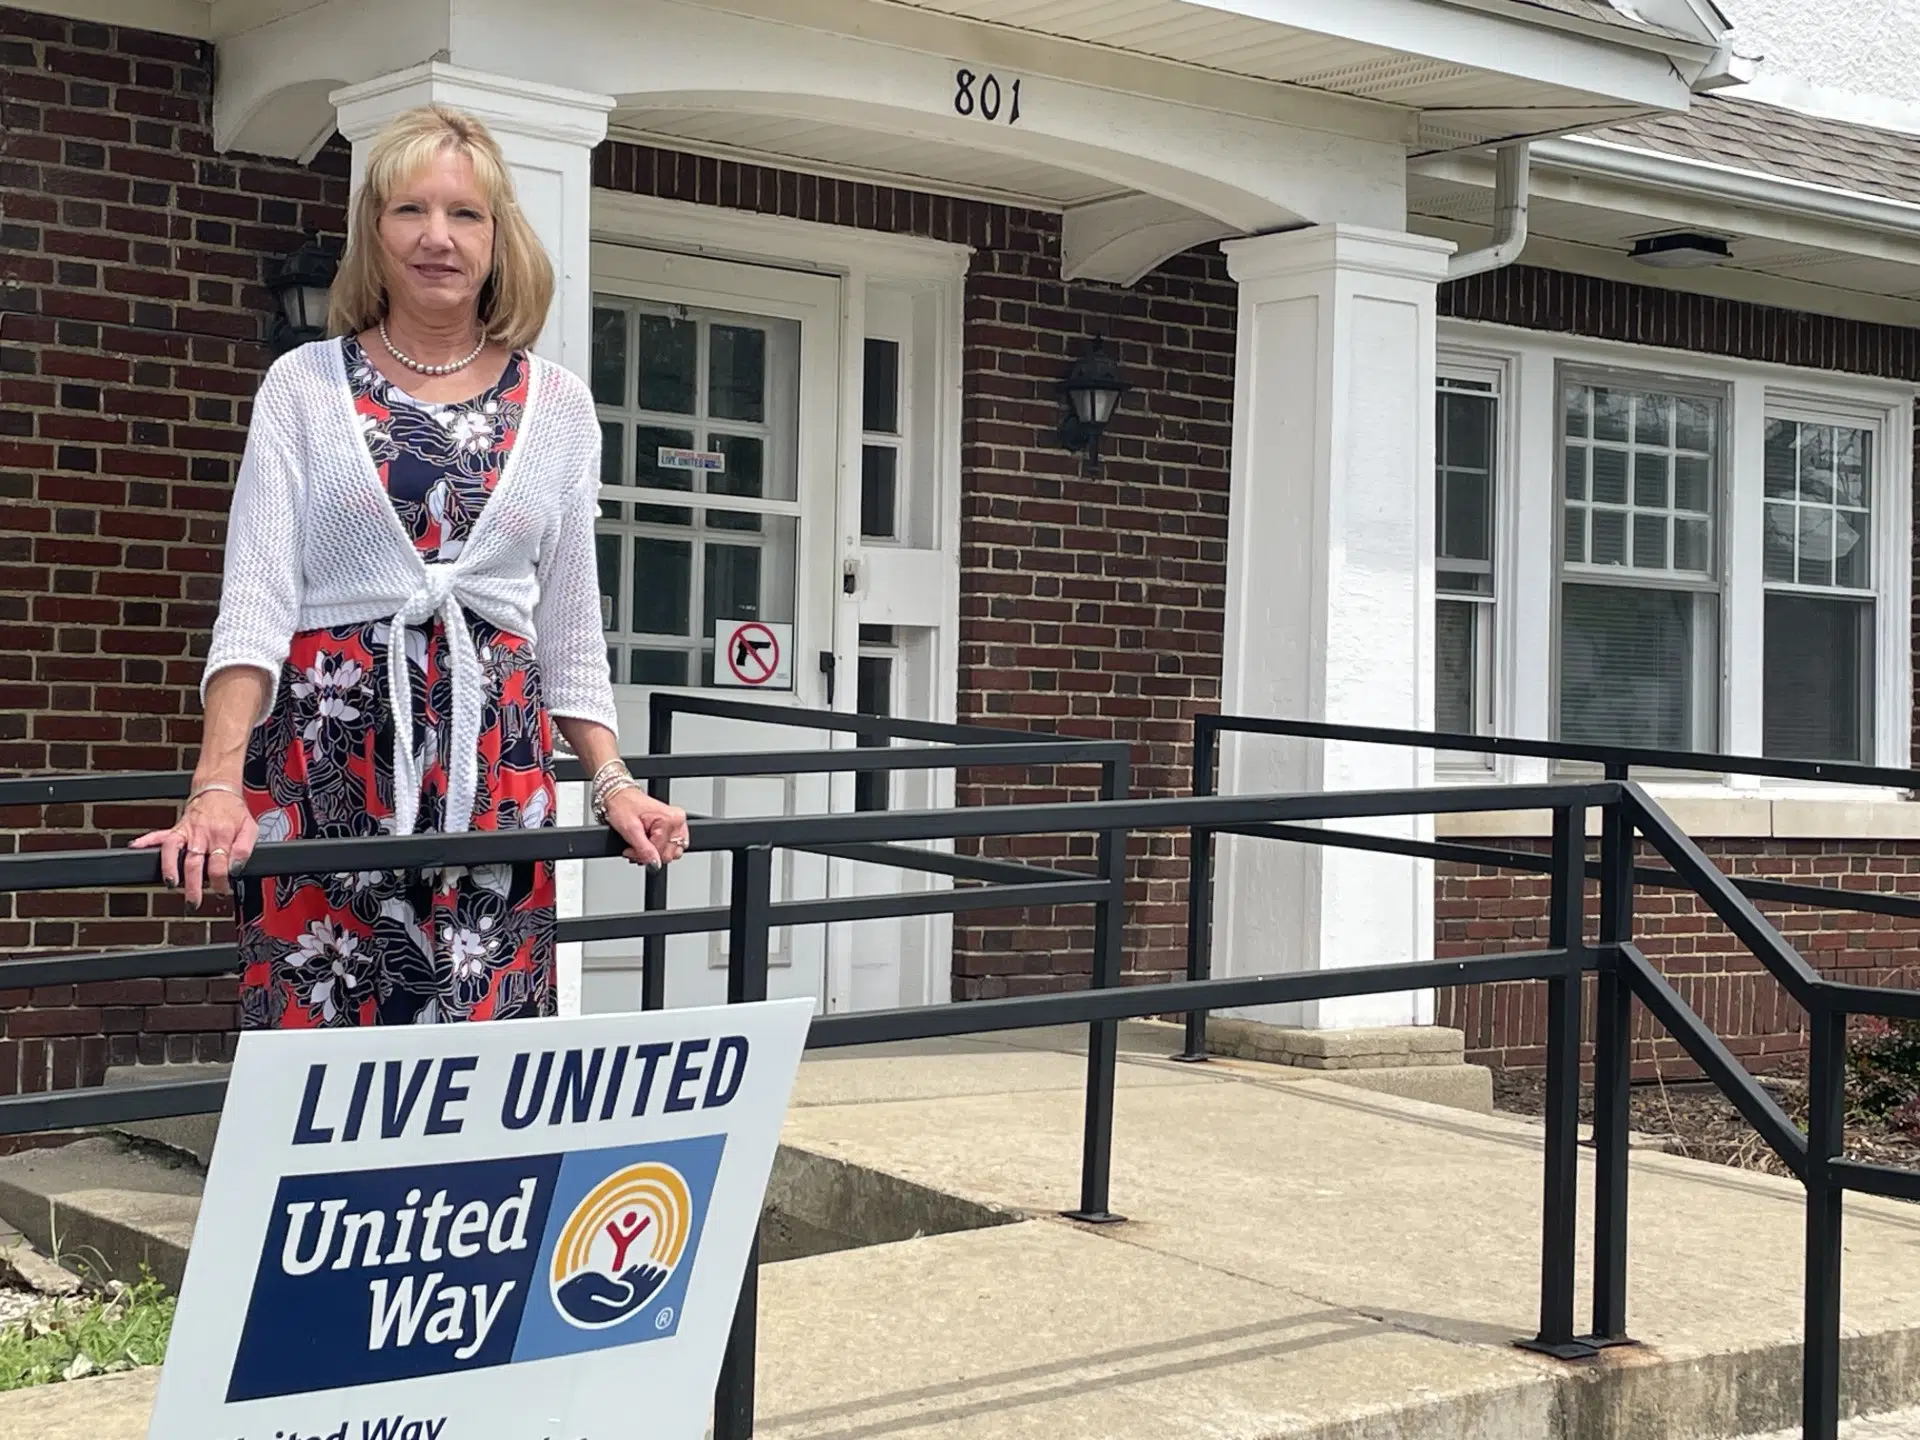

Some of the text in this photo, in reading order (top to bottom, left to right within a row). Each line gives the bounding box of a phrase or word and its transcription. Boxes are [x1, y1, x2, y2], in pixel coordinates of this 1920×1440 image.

[955, 68, 1020, 125] 801
[292, 1035, 750, 1145] LIVE UNITED
[281, 1176, 539, 1276] United
[369, 1271, 516, 1360] Way
